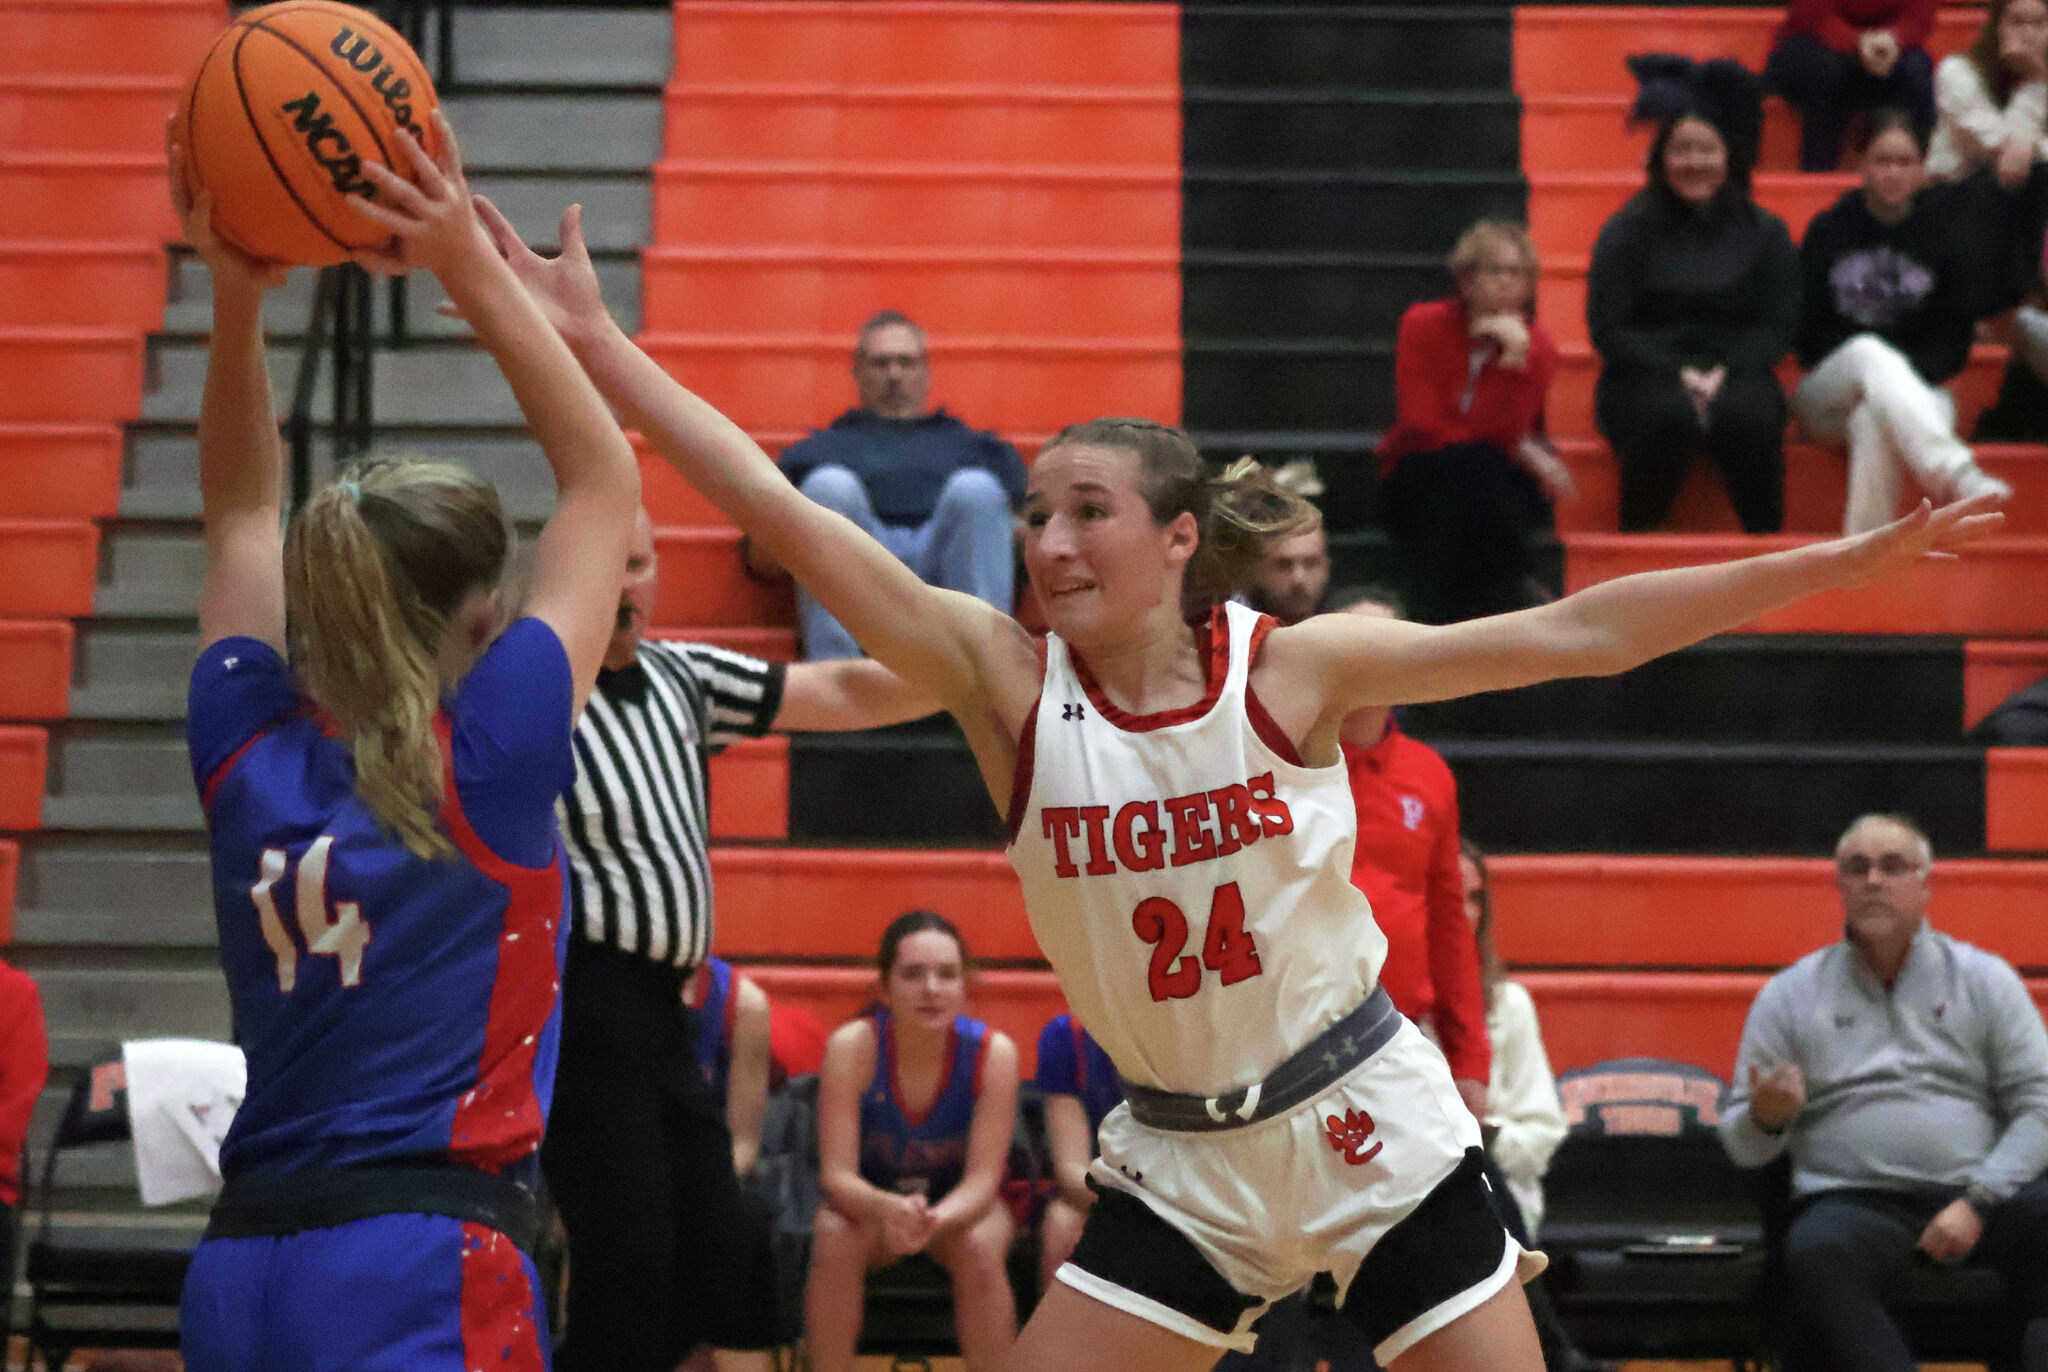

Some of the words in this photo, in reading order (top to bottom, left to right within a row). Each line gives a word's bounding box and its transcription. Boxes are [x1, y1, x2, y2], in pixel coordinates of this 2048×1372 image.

[1041, 771, 1294, 878] TIGERS
[251, 834, 372, 994] 14
[1132, 881, 1263, 1002] 24
